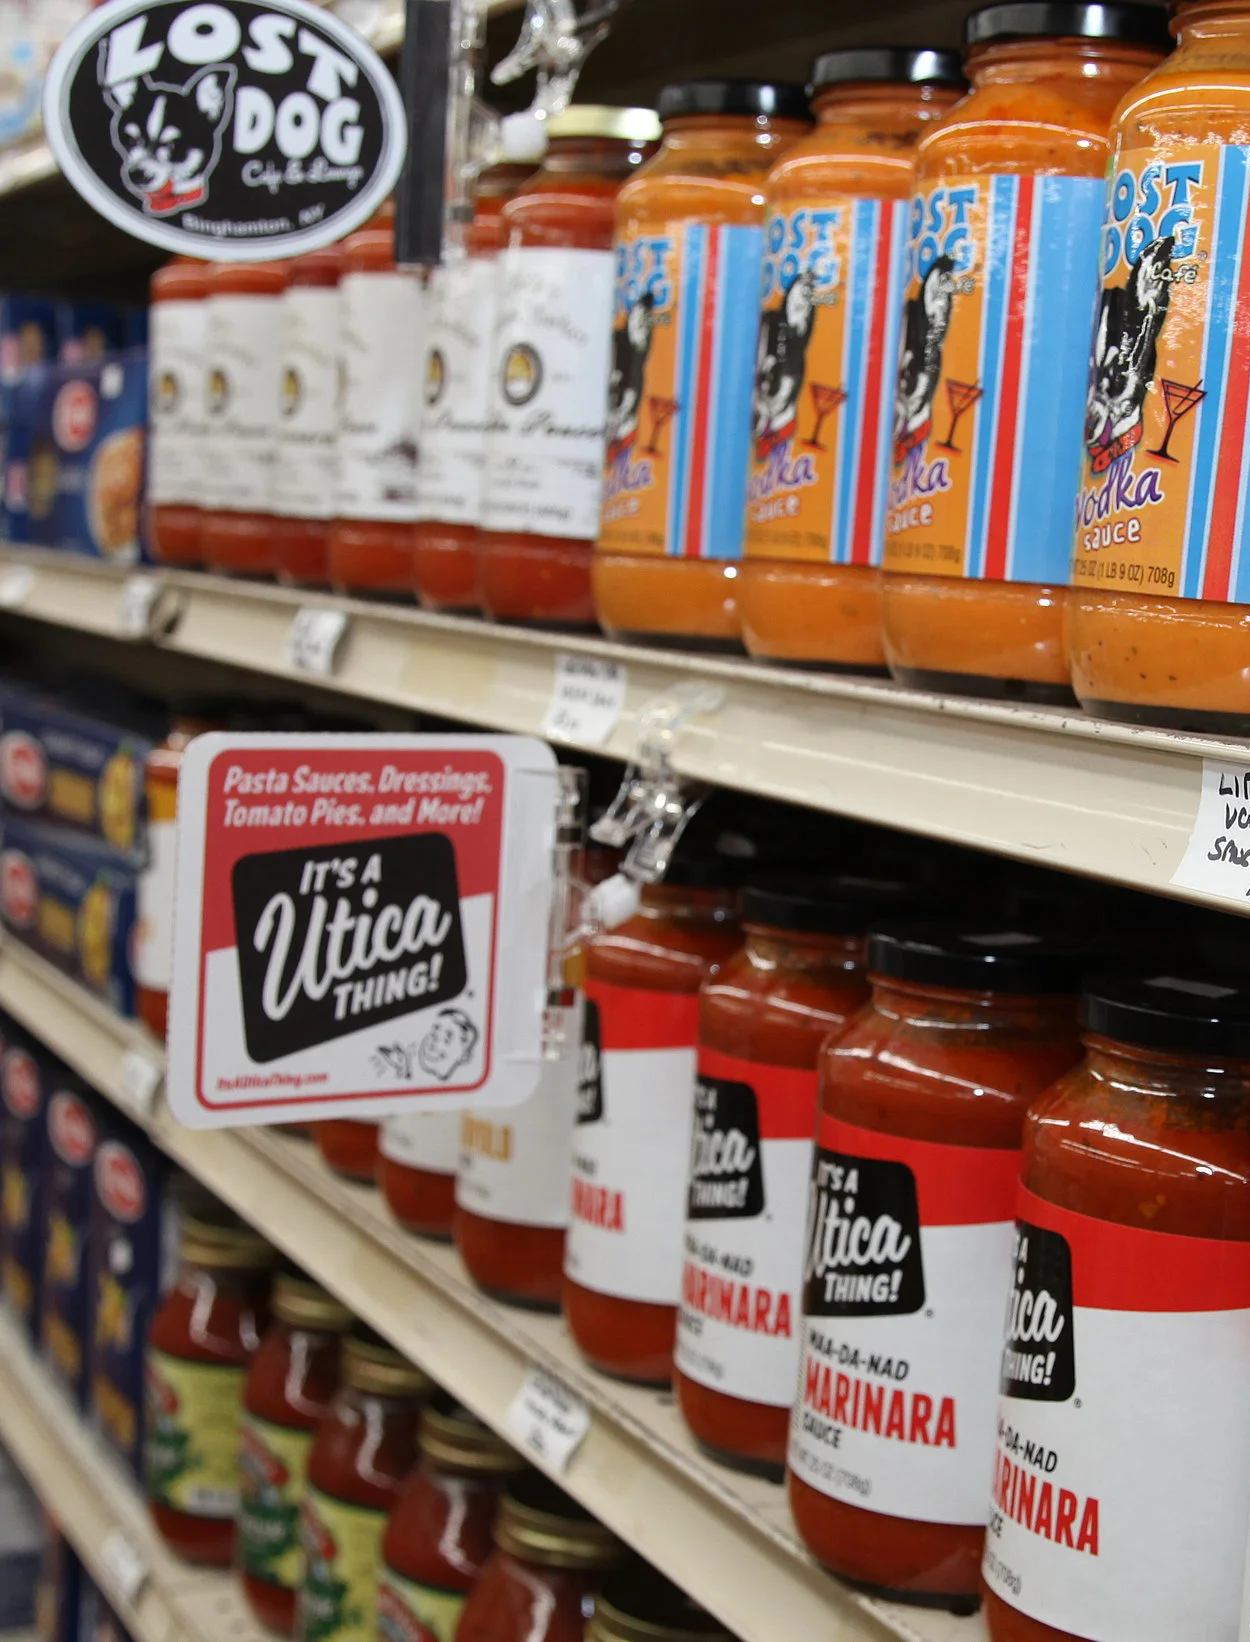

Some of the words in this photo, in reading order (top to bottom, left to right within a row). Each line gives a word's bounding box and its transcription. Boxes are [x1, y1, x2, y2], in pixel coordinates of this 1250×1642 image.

[104, 3, 359, 102] LOST
[233, 85, 364, 165] DOG
[910, 186, 977, 240] OST
[1112, 160, 1204, 222] OST
[768, 210, 838, 256] OST
[1083, 518, 1141, 551] sauce
[1105, 562, 1118, 579] LB
[1120, 564, 1126, 580] 9
[1127, 564, 1144, 585] OZ)
[1147, 566, 1176, 588] 708g
[223, 764, 290, 794] Pasta
[224, 798, 308, 827] Tomato
[369, 797, 416, 825] and
[416, 797, 486, 826] More!
[299, 858, 356, 896] IT'S
[360, 854, 382, 884] A
[253, 887, 453, 1021] Utica
[333, 954, 443, 1021] THING!
[844, 1168, 859, 1194] A
[683, 1256, 792, 1339] ARINARA
[824, 1269, 904, 1304] THING!
[1006, 1266, 1066, 1343] ica
[804, 1356, 957, 1449] MARINARA
[802, 1411, 842, 1450] SAUCE
